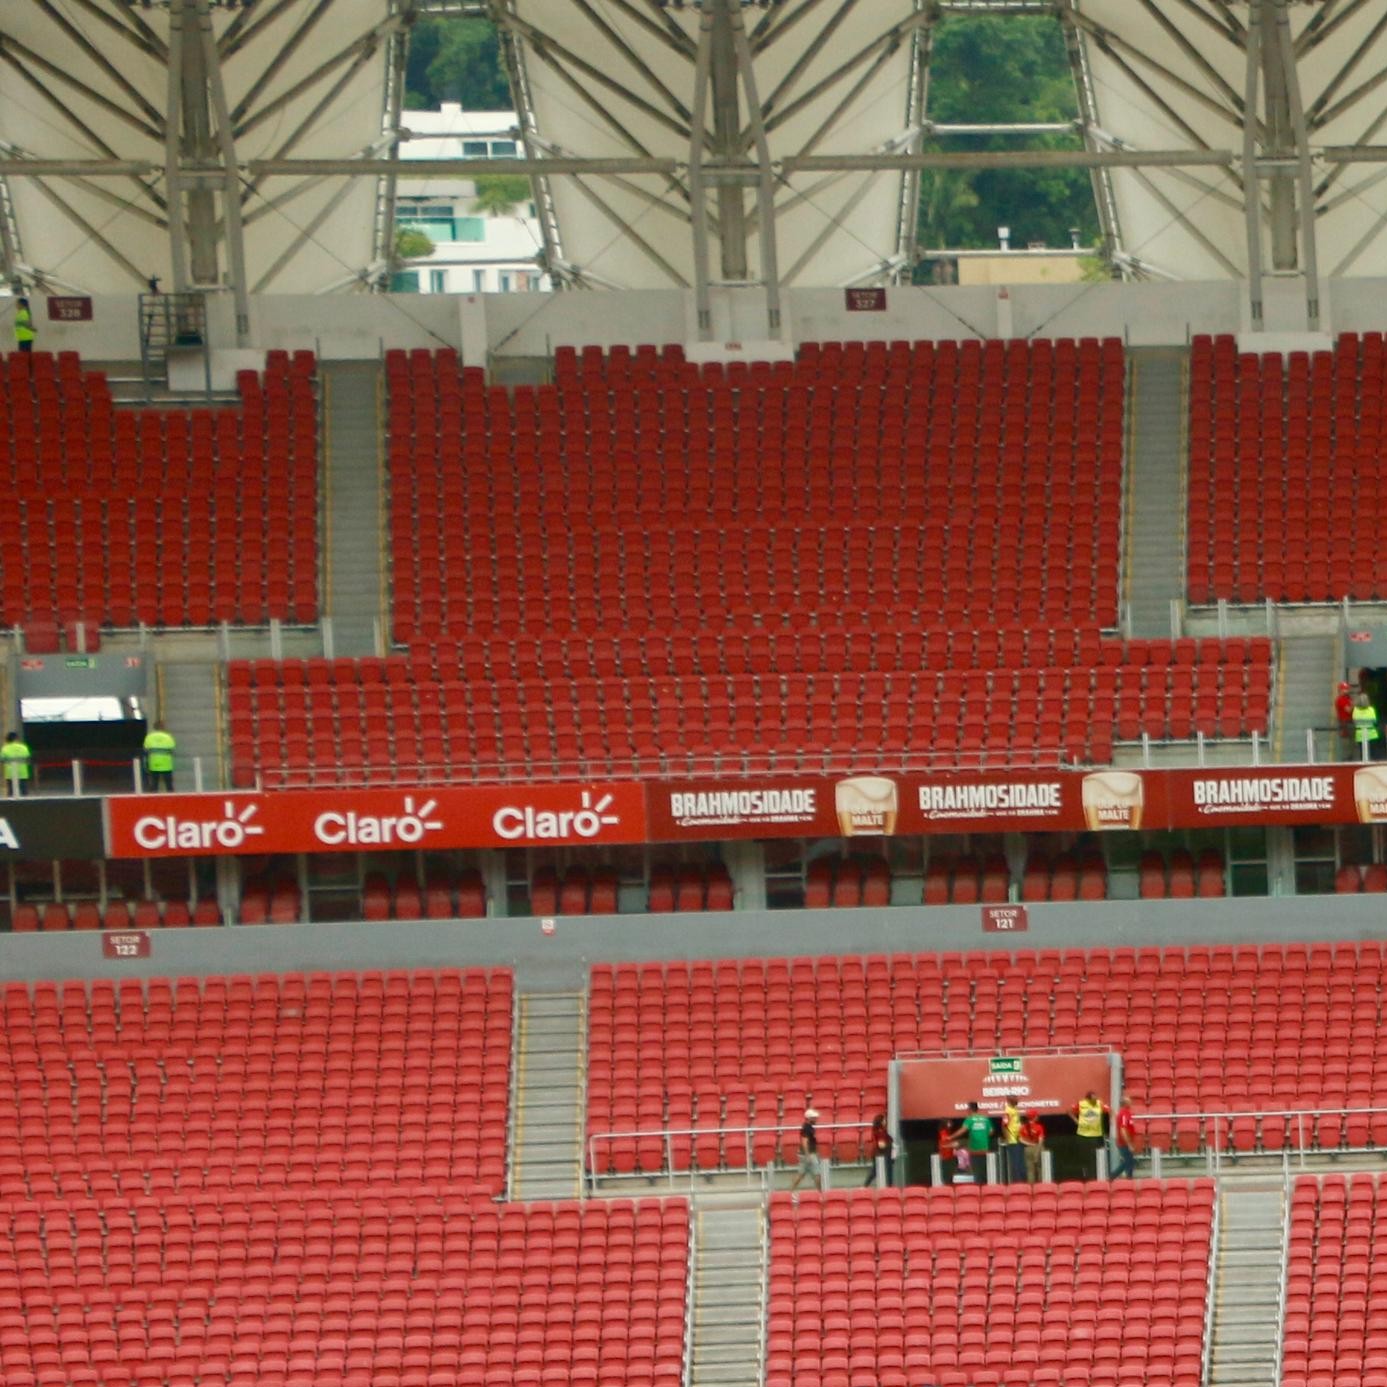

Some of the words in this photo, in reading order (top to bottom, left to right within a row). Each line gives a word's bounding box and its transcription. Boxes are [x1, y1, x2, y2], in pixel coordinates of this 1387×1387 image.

[918, 783, 1062, 810] BRAHMOSIDADE
[1193, 777, 1334, 804] BRAHMOSIDADE
[670, 789, 816, 817] BRAHMOSIDADE
[493, 806, 600, 839] Claro
[851, 814, 884, 826] MALTE
[1097, 809, 1129, 821] MALTE
[133, 814, 245, 849] Claro
[314, 811, 424, 845] Claro
[989, 909, 1018, 918] SETOR
[995, 919, 1014, 928] 121
[110, 935, 140, 944] SETOR
[115, 945, 138, 955] 122
